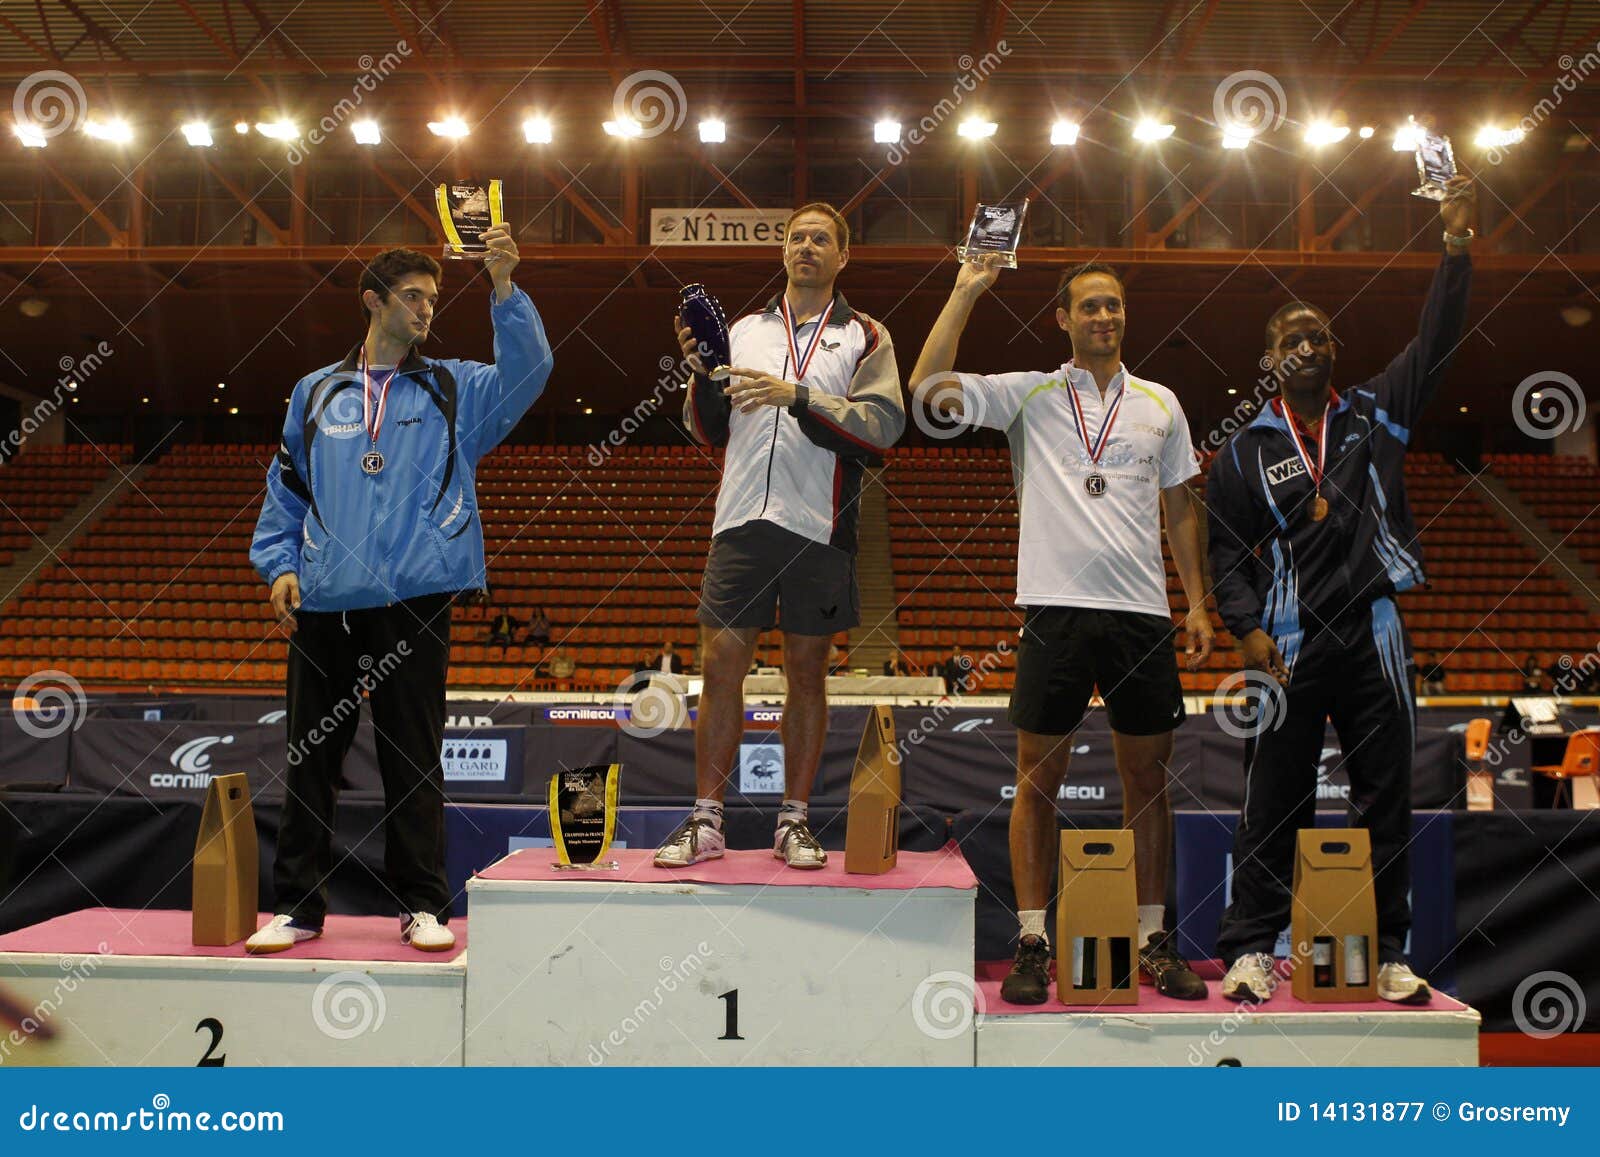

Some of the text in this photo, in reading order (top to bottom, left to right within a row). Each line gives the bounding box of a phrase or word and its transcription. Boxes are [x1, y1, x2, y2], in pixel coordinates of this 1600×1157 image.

[682, 212, 785, 241] Nîmes
[322, 423, 362, 436] TIBHAR
[549, 708, 616, 720] cornilleau
[459, 761, 499, 770] GARD
[717, 989, 744, 1040] 1
[195, 1018, 226, 1067] 2
